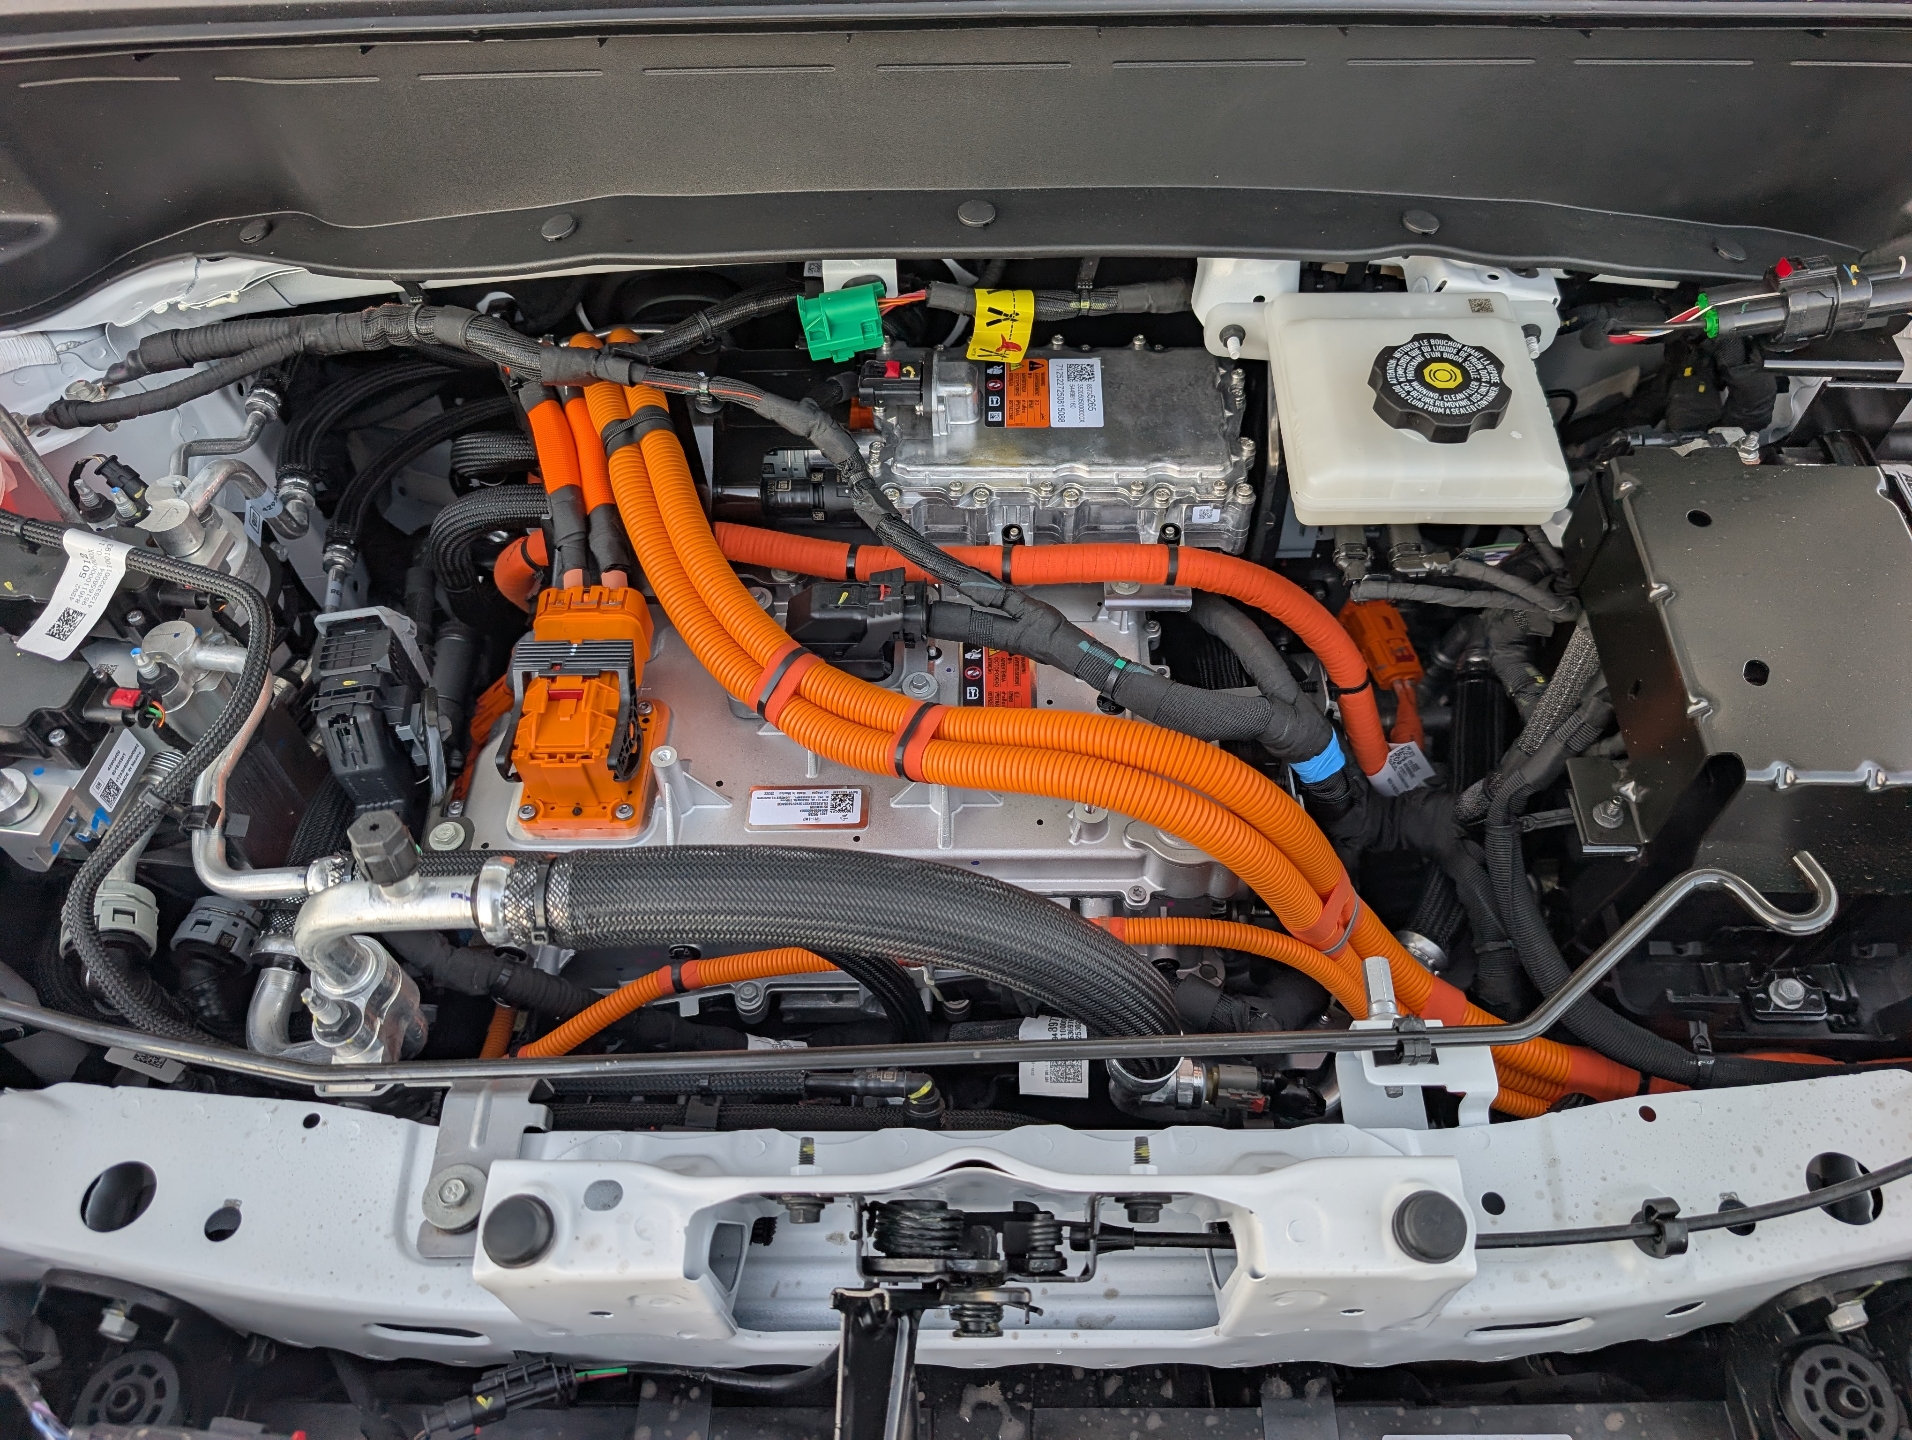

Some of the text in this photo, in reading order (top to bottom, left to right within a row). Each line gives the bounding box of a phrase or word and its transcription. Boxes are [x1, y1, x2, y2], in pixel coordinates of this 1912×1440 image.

[1430, 339, 1462, 349] BOUCHON
[1462, 346, 1484, 358] AVANT
[1433, 346, 1458, 354] LIQUIDE
[1458, 350, 1469, 358] DE
[1443, 351, 1464, 363] BIDON
[1410, 390, 1436, 405] BEFORE
[1443, 392, 1466, 401] CLEAN
[1463, 381, 1480, 397] FILLER
[1404, 395, 1424, 408] FLUID
[1424, 404, 1444, 414] FROM
[1451, 405, 1477, 415] SEALED
